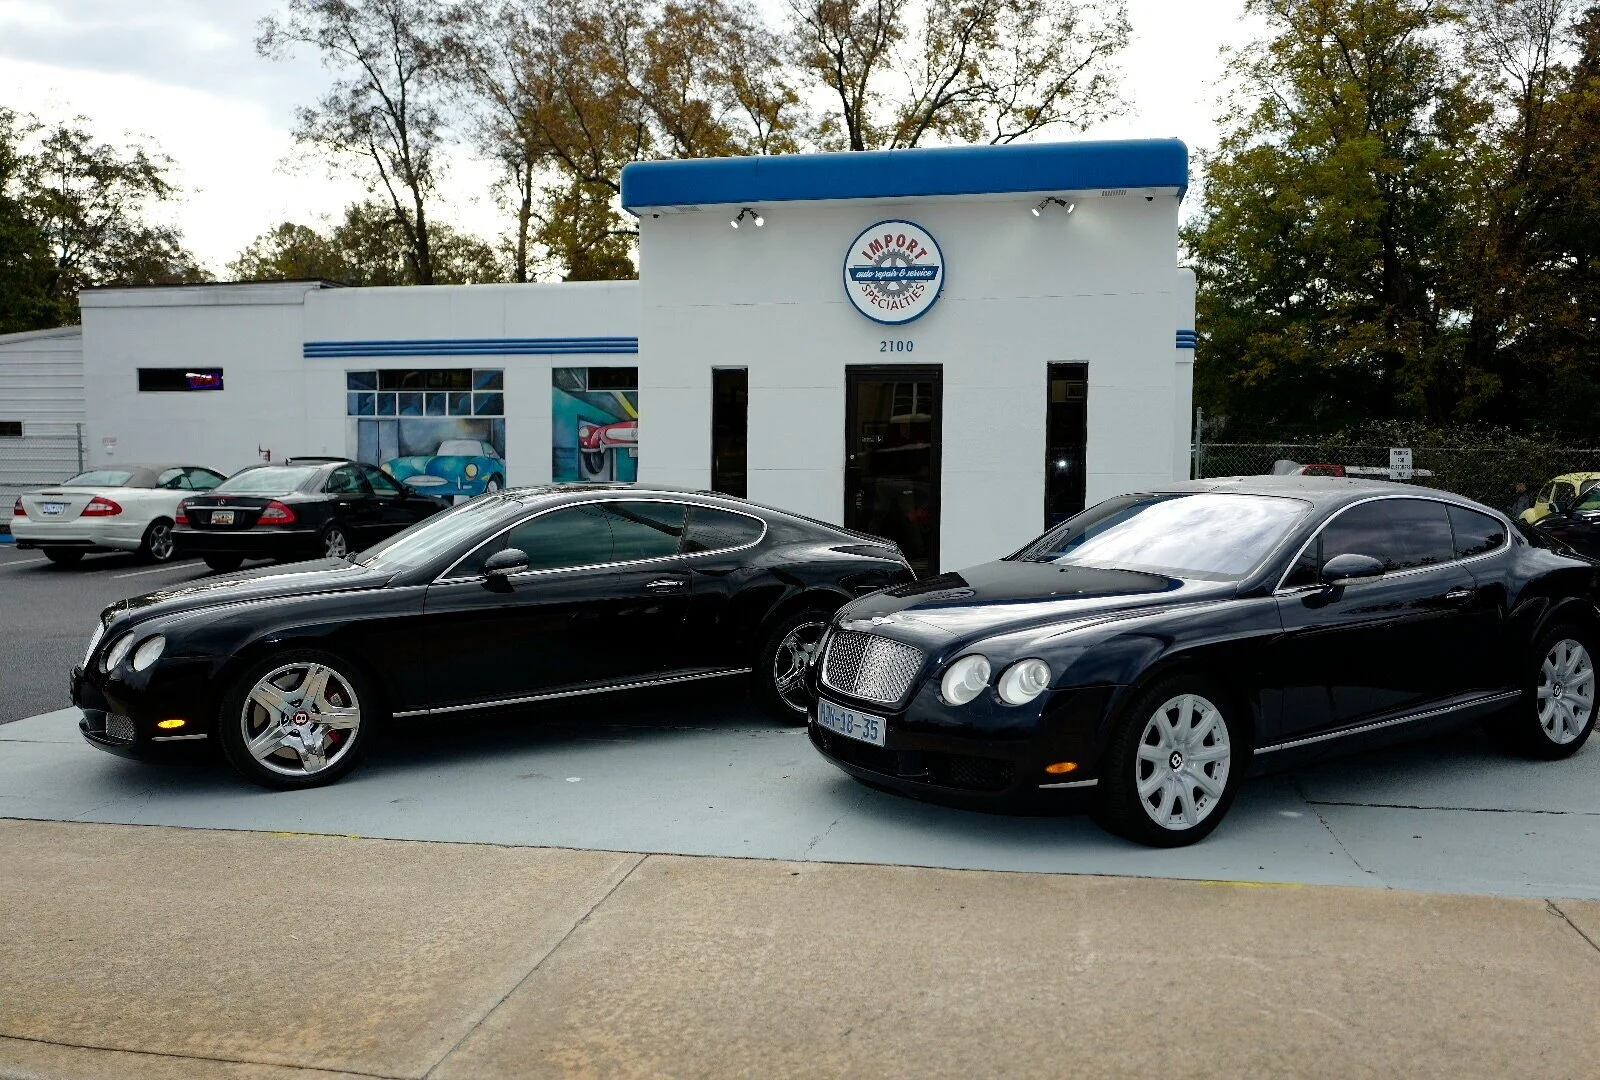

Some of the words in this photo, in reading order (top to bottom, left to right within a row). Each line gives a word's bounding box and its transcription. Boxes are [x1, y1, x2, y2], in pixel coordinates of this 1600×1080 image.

[862, 234, 928, 260] IMPORT
[856, 270, 874, 278] auto
[875, 268, 898, 279] repair
[898, 268, 906, 277] &
[906, 267, 933, 277] service
[862, 283, 925, 310] SPECIALTIES
[880, 341, 913, 352] 2100
